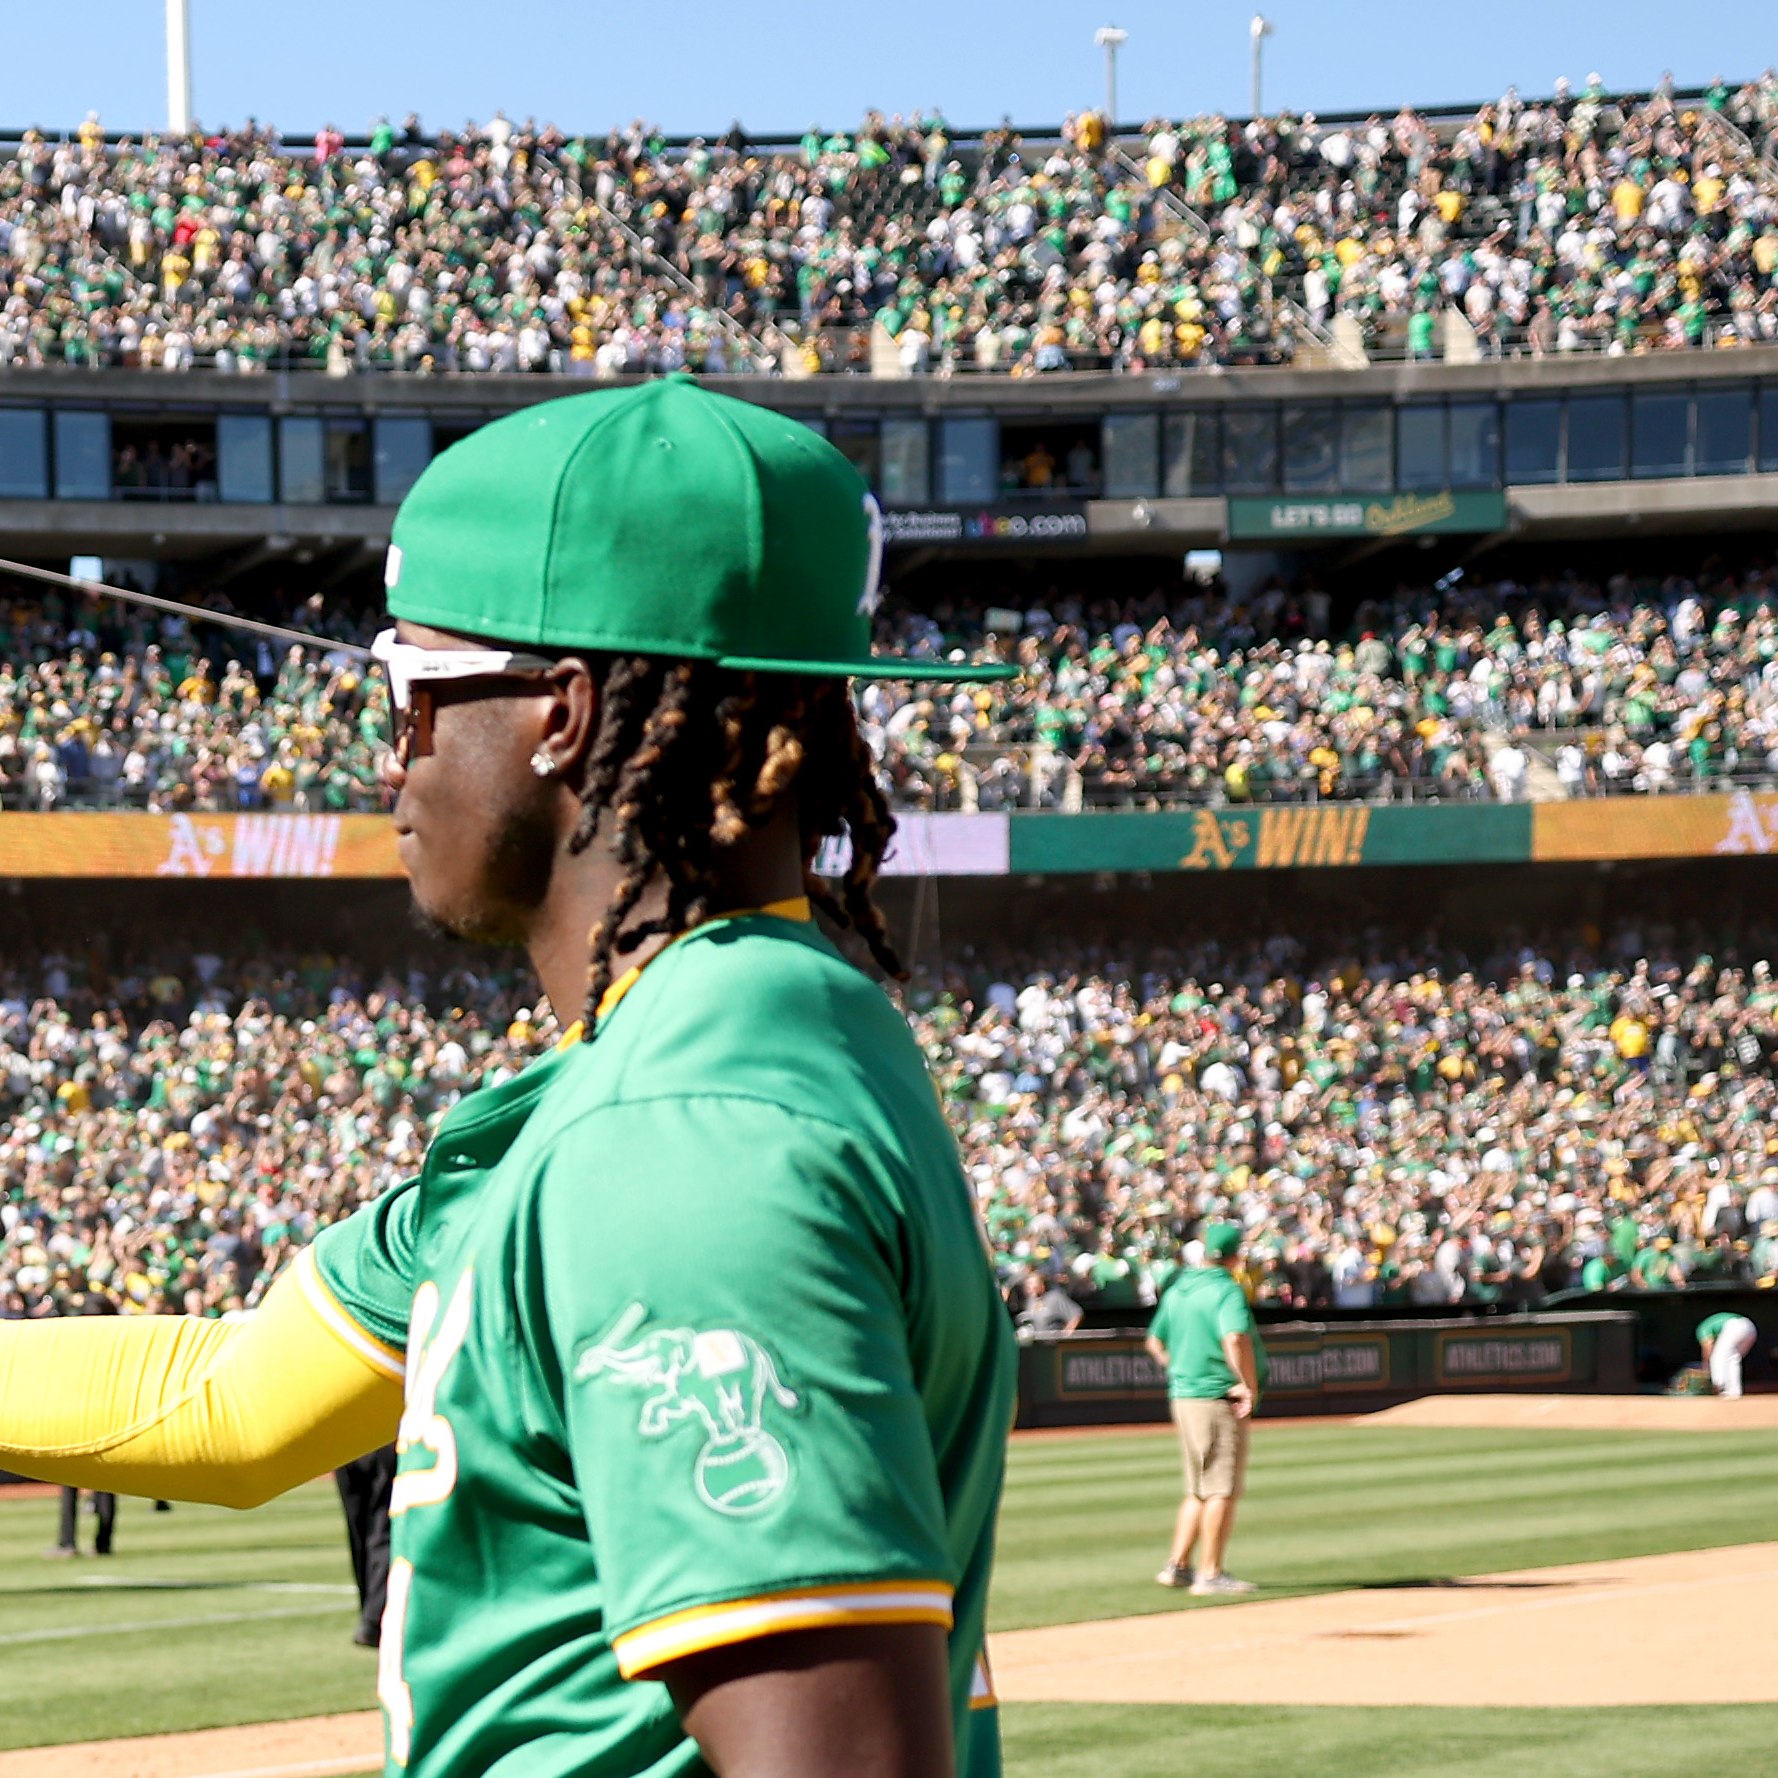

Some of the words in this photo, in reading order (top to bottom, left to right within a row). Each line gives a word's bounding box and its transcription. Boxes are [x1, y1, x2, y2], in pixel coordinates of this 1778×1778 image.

[1271, 504, 1330, 528] LET'S
[155, 812, 226, 876] A's
[232, 814, 343, 877] WIN!
[1178, 808, 1251, 870] A's
[1256, 806, 1371, 869] WIN!
